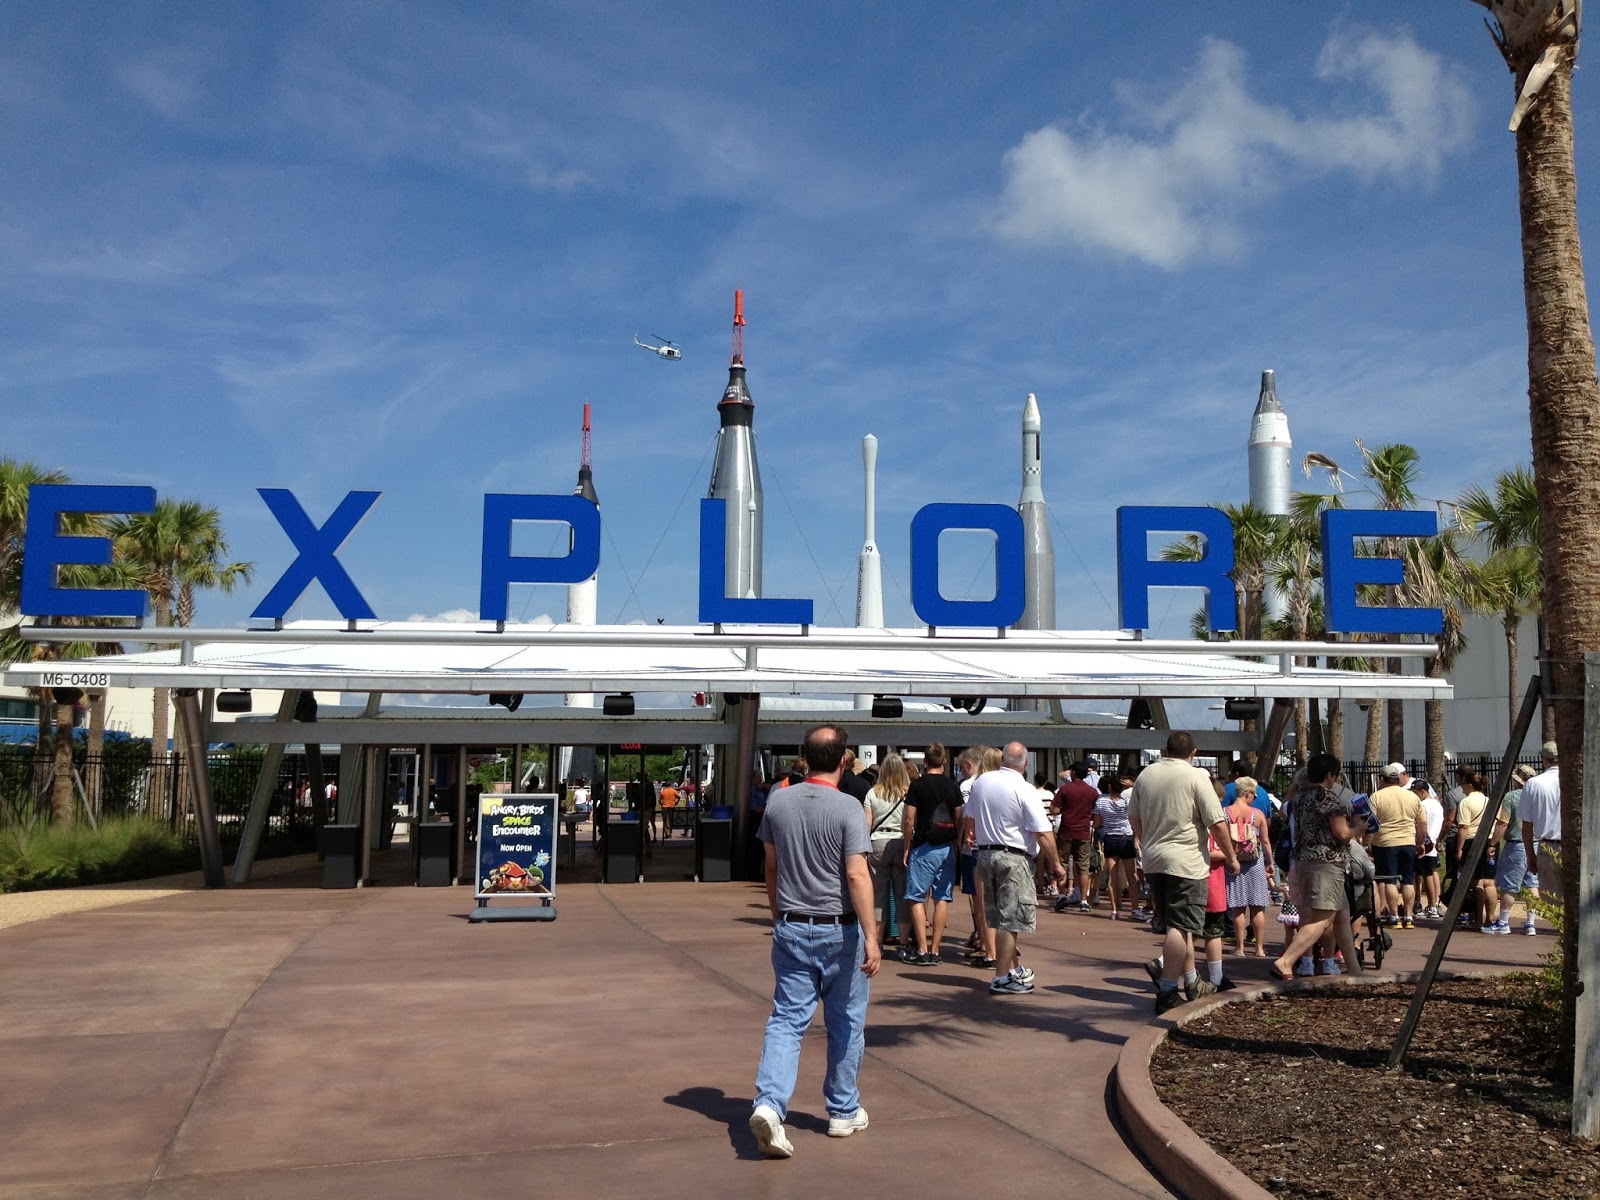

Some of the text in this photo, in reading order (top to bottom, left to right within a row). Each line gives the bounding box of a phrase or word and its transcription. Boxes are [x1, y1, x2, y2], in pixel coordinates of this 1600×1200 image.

[865, 545, 873, 553] 19
[20, 484, 1444, 636] EXPLORE
[42, 673, 108, 686] M6-0408
[864, 751, 872, 759] 19
[490, 805, 545, 816] ANGRY BIRDS
[502, 816, 532, 826] SPACE
